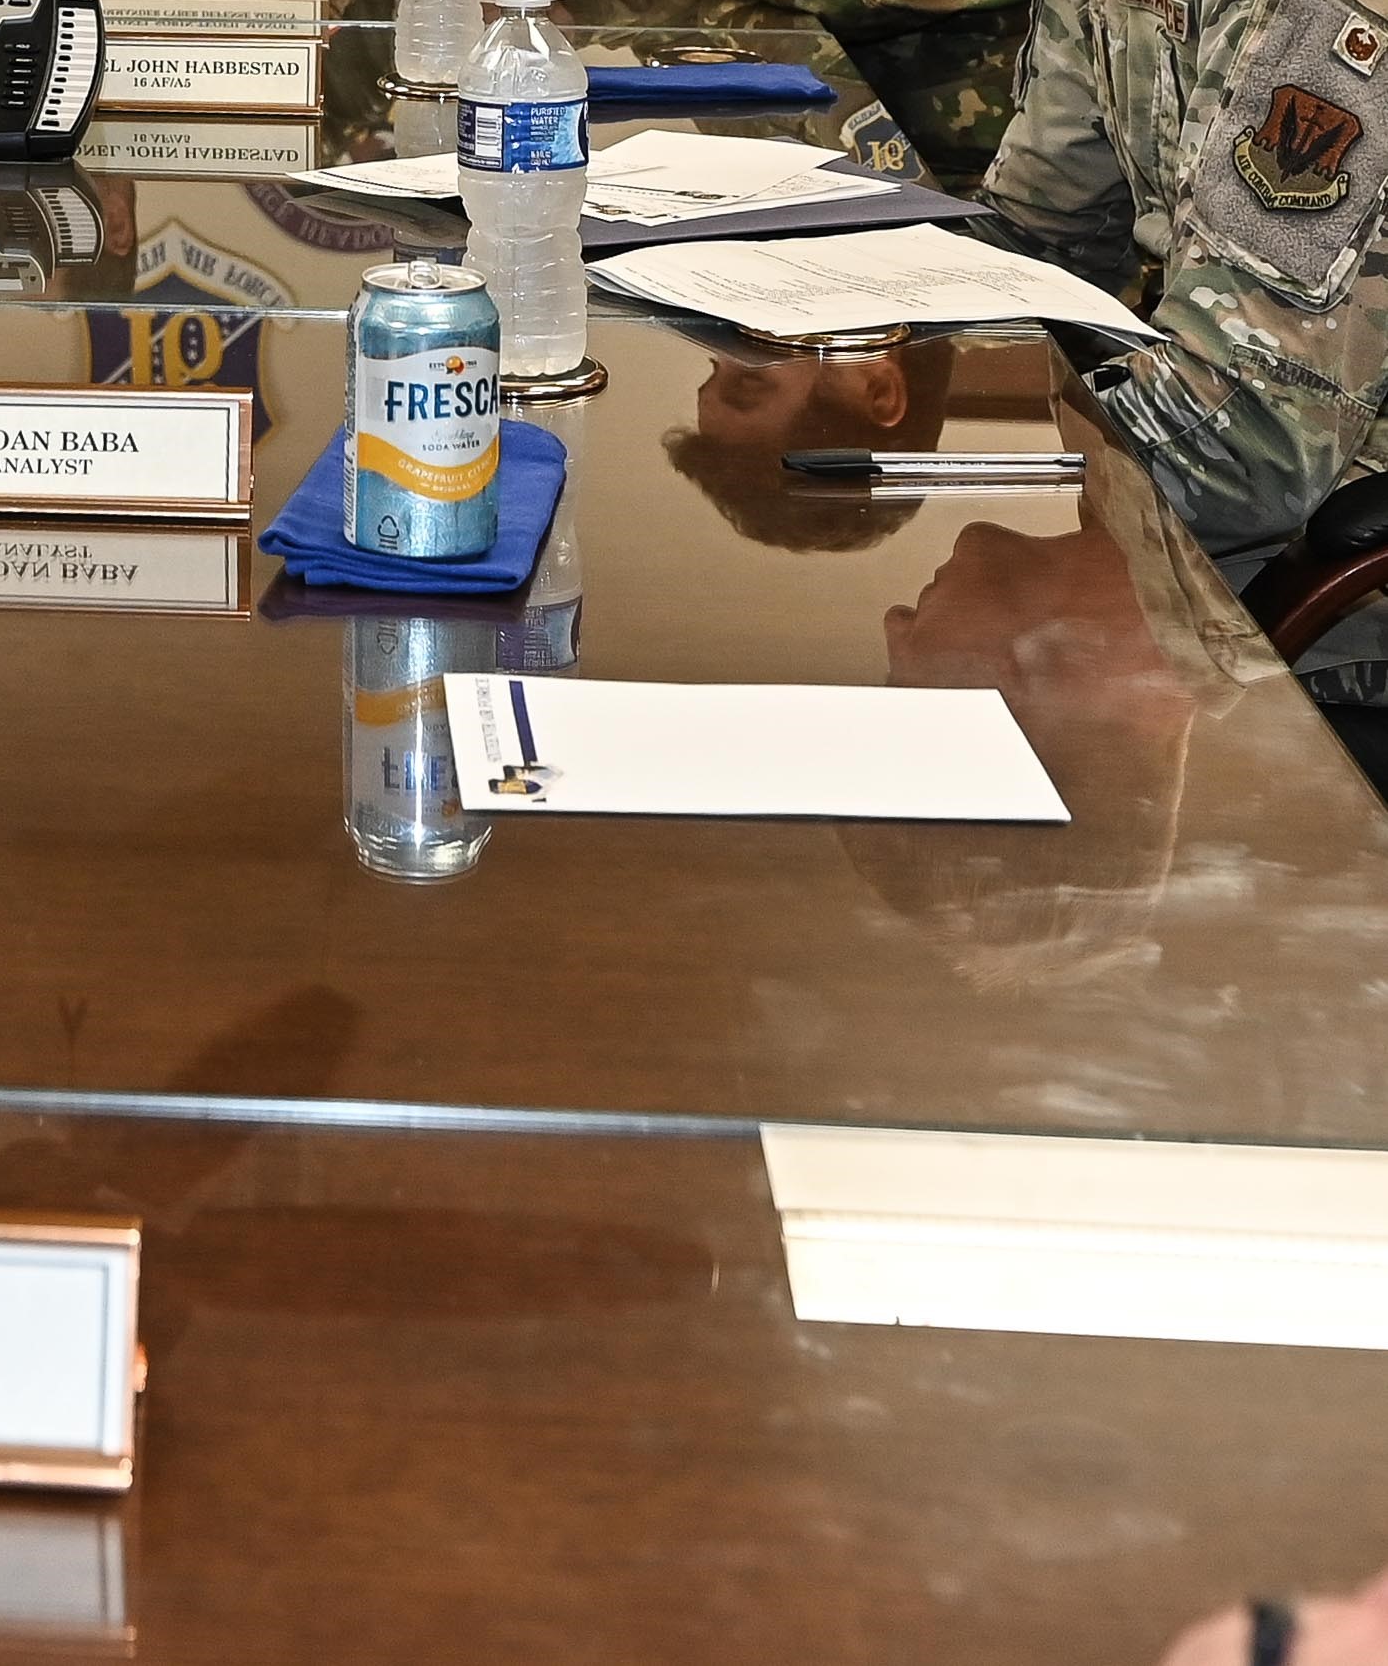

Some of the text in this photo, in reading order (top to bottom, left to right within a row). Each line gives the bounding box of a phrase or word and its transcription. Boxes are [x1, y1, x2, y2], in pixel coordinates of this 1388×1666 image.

[127, 60, 179, 74] JOHN
[186, 61, 299, 75] HABBESTAD
[134, 77, 191, 88] 16 AF/A5
[530, 116, 559, 125] WATER
[1278, 194, 1331, 206] COMMAND
[385, 374, 498, 422] FRESCA
[60, 431, 138, 453] BABA
[422, 439, 480, 452] SODA WATER
